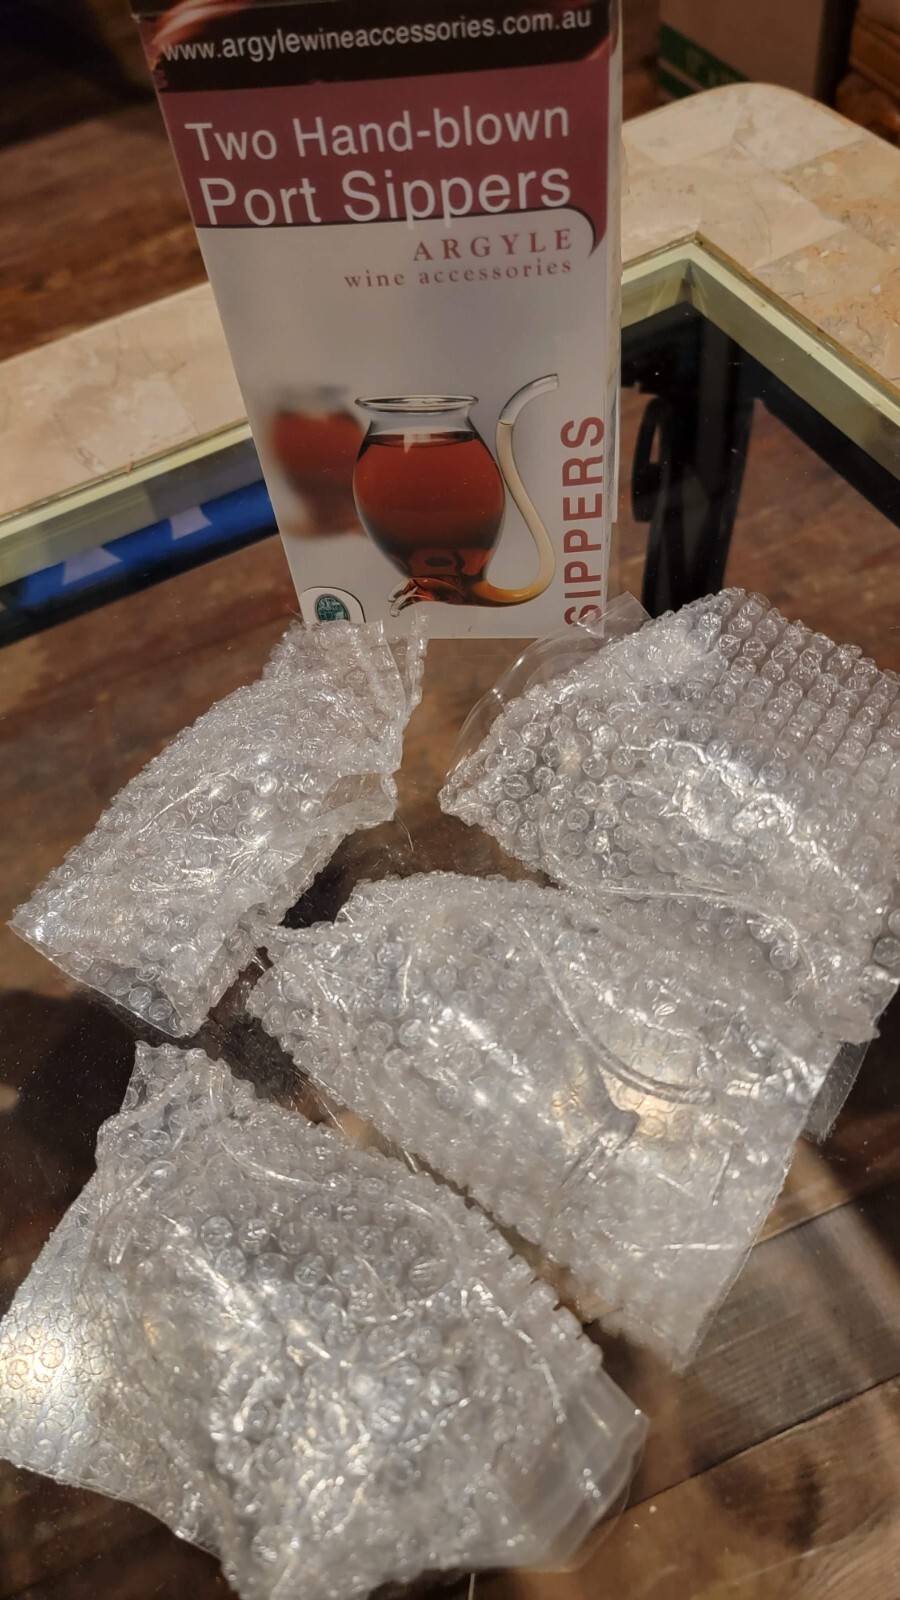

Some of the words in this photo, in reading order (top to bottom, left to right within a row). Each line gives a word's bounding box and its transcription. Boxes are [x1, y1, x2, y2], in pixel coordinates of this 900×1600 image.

[162, 9, 592, 63] www.argylewineaccessories.com.au
[185, 122, 277, 161] Two
[292, 105, 569, 157] Hand-blown
[198, 176, 322, 226] Port
[342, 166, 571, 230] Sippers
[413, 228, 572, 261] ARGYLE
[344, 270, 404, 288] wine
[419, 258, 572, 284] accessories
[560, 416, 604, 627] SIPPERS
